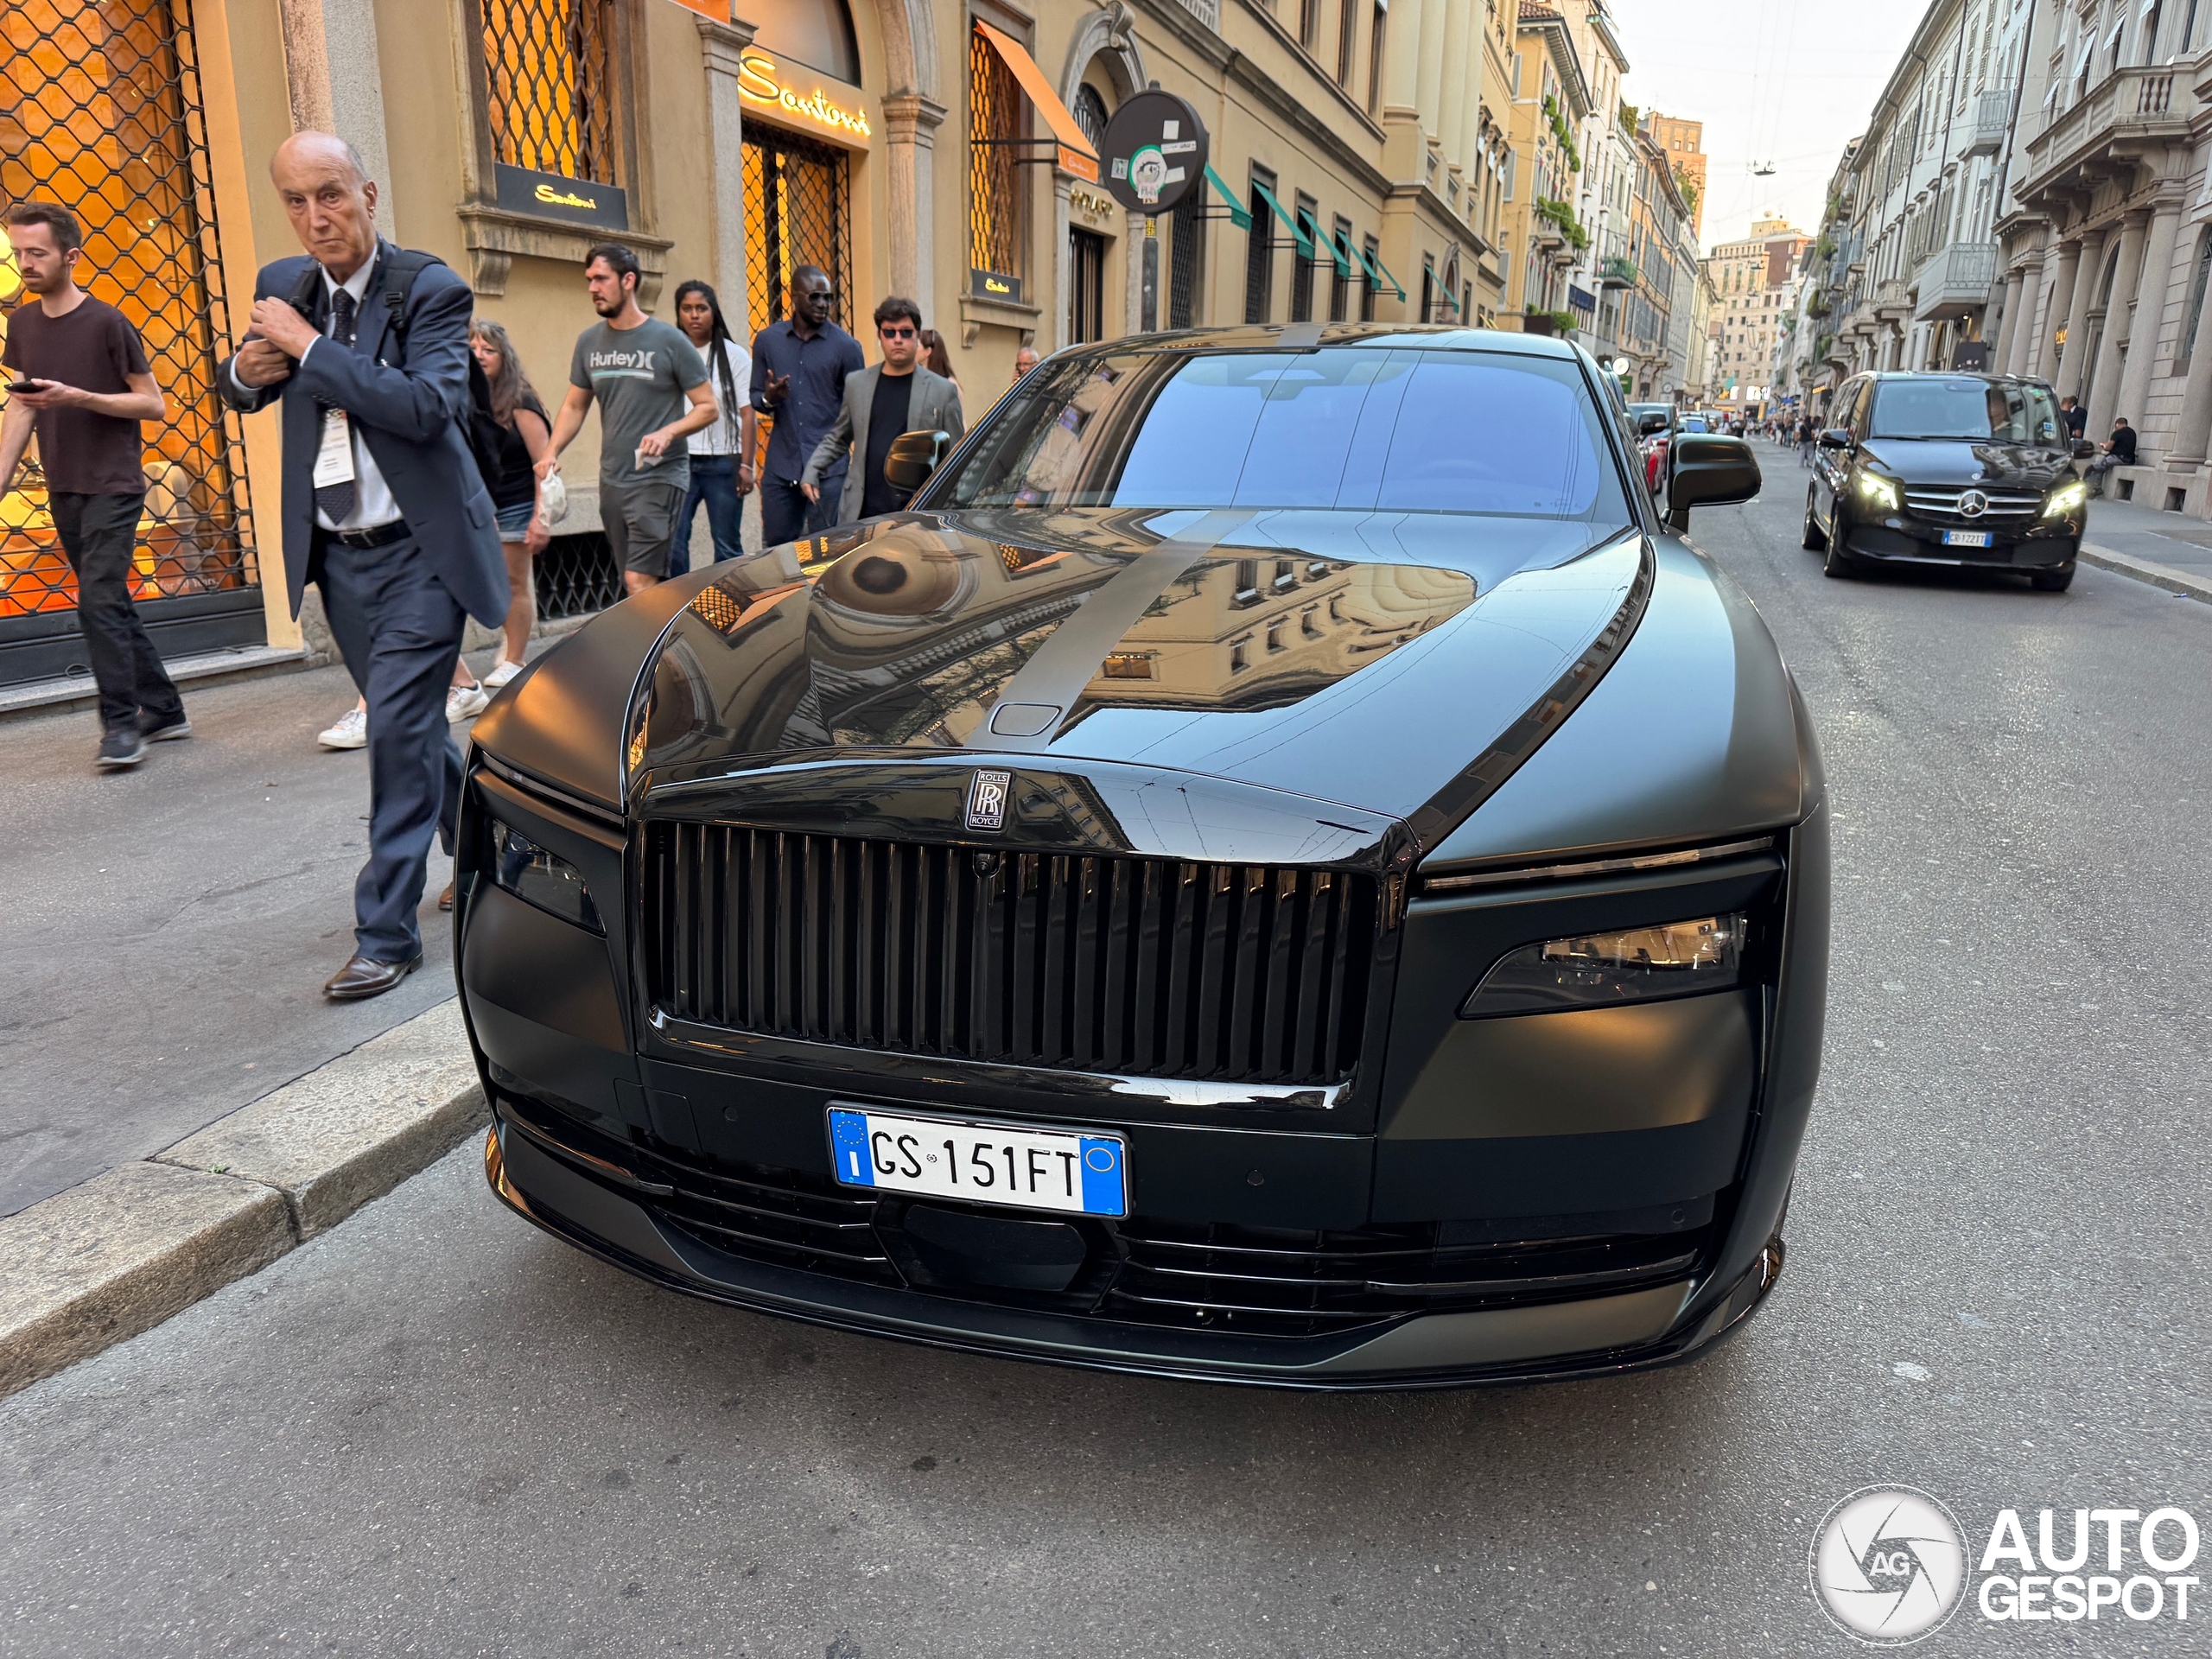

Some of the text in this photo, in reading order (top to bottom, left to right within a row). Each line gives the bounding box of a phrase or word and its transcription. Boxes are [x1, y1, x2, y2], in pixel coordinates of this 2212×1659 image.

[737, 55, 871, 136] Santoni
[535, 184, 597, 209] Santoni
[589, 349, 637, 368] Hurley
[980, 773, 1007, 782] ROLLS
[971, 816, 999, 826] ROYCE
[870, 1130, 923, 1179] GS
[943, 1139, 1080, 1197] 151FT
